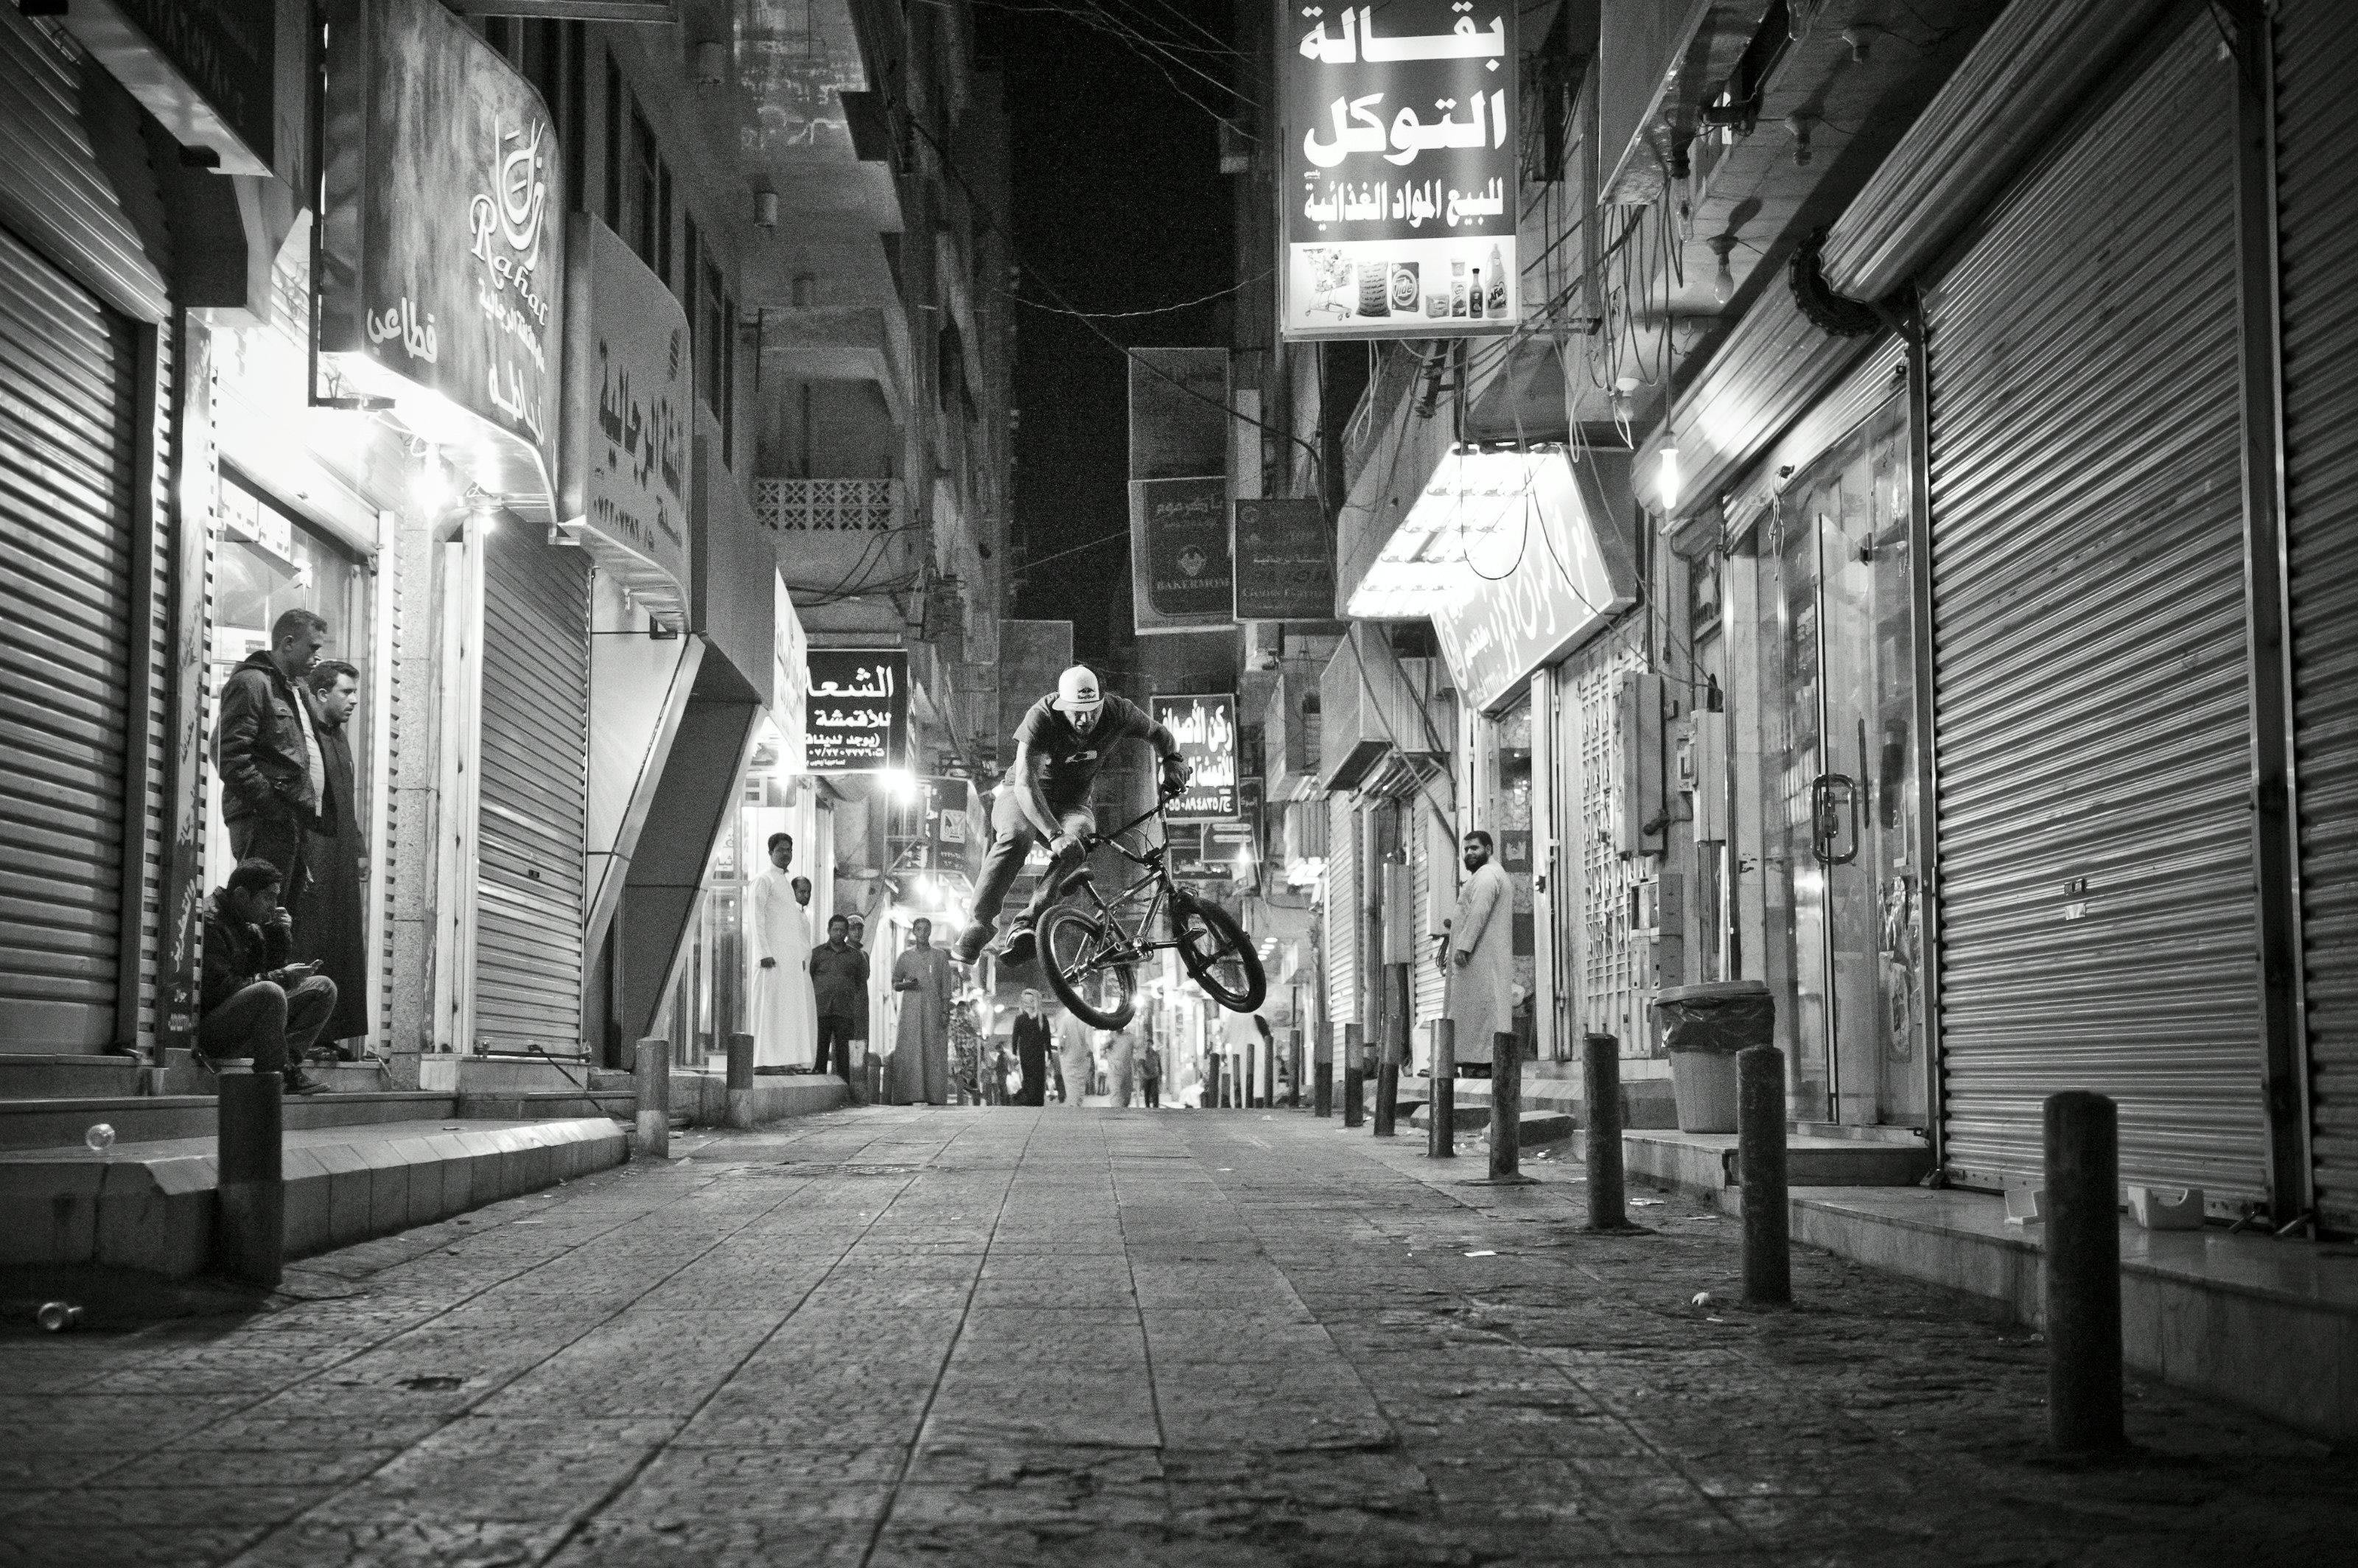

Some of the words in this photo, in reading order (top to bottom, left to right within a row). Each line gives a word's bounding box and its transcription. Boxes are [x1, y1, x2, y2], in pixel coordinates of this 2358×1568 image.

[1299, 1, 1505, 71] بقالة
[1304, 88, 1507, 168] التوكل
[1304, 178, 1388, 231] الغذائية
[1392, 178, 1441, 228] المواد
[1446, 176, 1503, 227] للبيع
